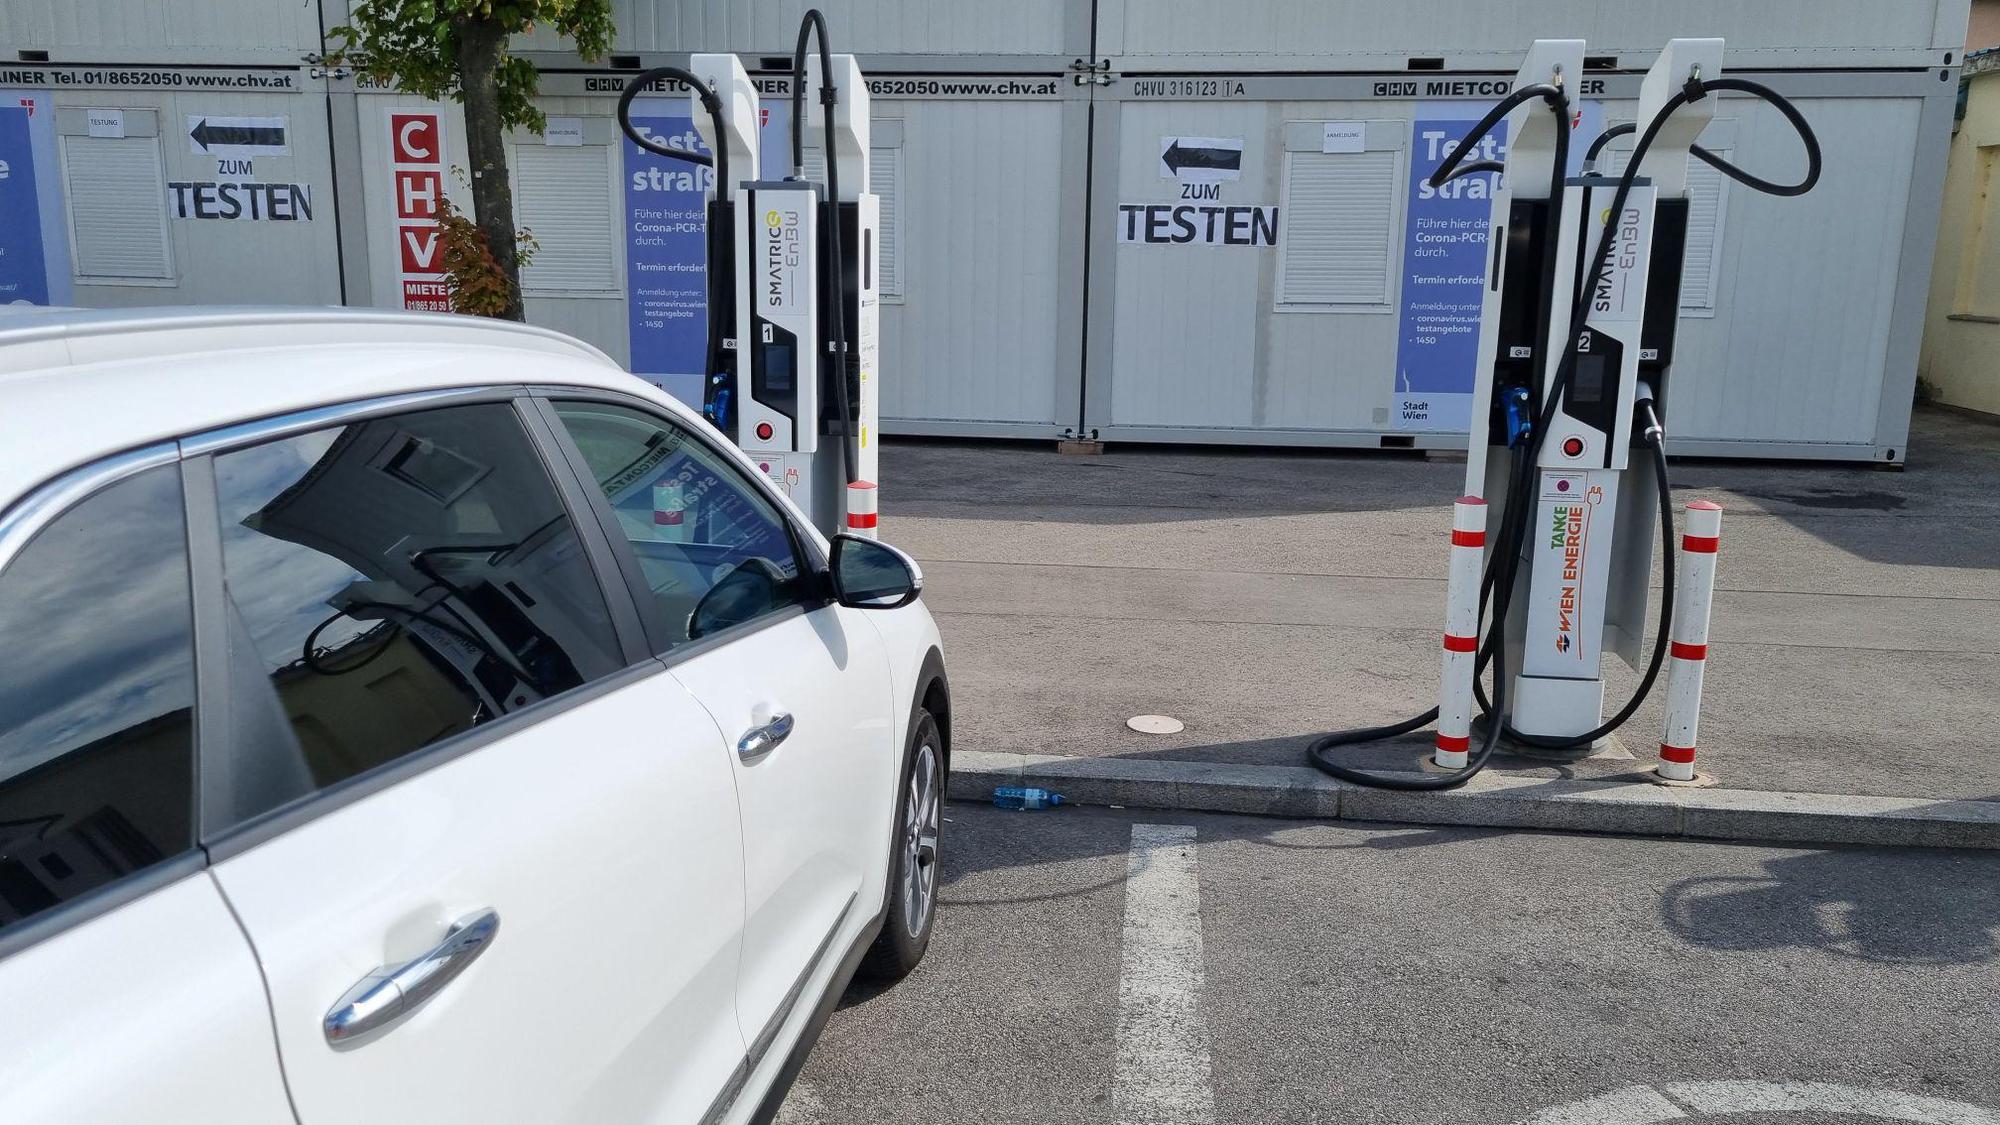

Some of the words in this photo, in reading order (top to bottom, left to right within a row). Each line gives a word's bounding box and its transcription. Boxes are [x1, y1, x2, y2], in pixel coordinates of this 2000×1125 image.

[0, 71, 45, 84] INER
[51, 71, 82, 84] Tel.
[84, 71, 182, 86] 01/8652050
[185, 73, 292, 88] www.chv.at
[585, 78, 624, 92] CHV
[942, 80, 1057, 96] www.chv.at
[1134, 81, 1165, 96] CHVU
[1170, 81, 1217, 96] 316123
[1374, 82, 1417, 97] CHV
[218, 160, 253, 176] ZUM
[633, 164, 713, 192] straß
[1181, 183, 1220, 200] ZUM
[169, 182, 313, 221] TESTEN
[634, 208, 662, 219] Führe
[664, 209, 683, 219] hier
[635, 222, 706, 233] Corona-PCR-T
[1119, 205, 1279, 246] TESTEN
[1417, 218, 1448, 229] Führe
[1450, 218, 1472, 229] hier
[635, 236, 667, 247] durch.
[1416, 232, 1488, 243] Corona-PCR-
[1414, 246, 1449, 257] durch.
[636, 262, 666, 271] Termin
[667, 262, 707, 272] erforderl
[1412, 275, 1446, 285] Termin
[1448, 275, 1484, 285] erforde
[1410, 302, 1457, 313] Anmeldung
[645, 320, 664, 329] 1450
[1416, 325, 1472, 335] testangebote
[764, 328, 772, 341] 1
[1416, 336, 1437, 345] 1450
[1578, 335, 1591, 349] 2
[1403, 401, 1428, 411] Stadt
[1402, 411, 1428, 420] Wien
[1551, 506, 1568, 550] TANKE
[1563, 507, 1583, 580] ENERGIE
[1558, 587, 1577, 632] WIEN
